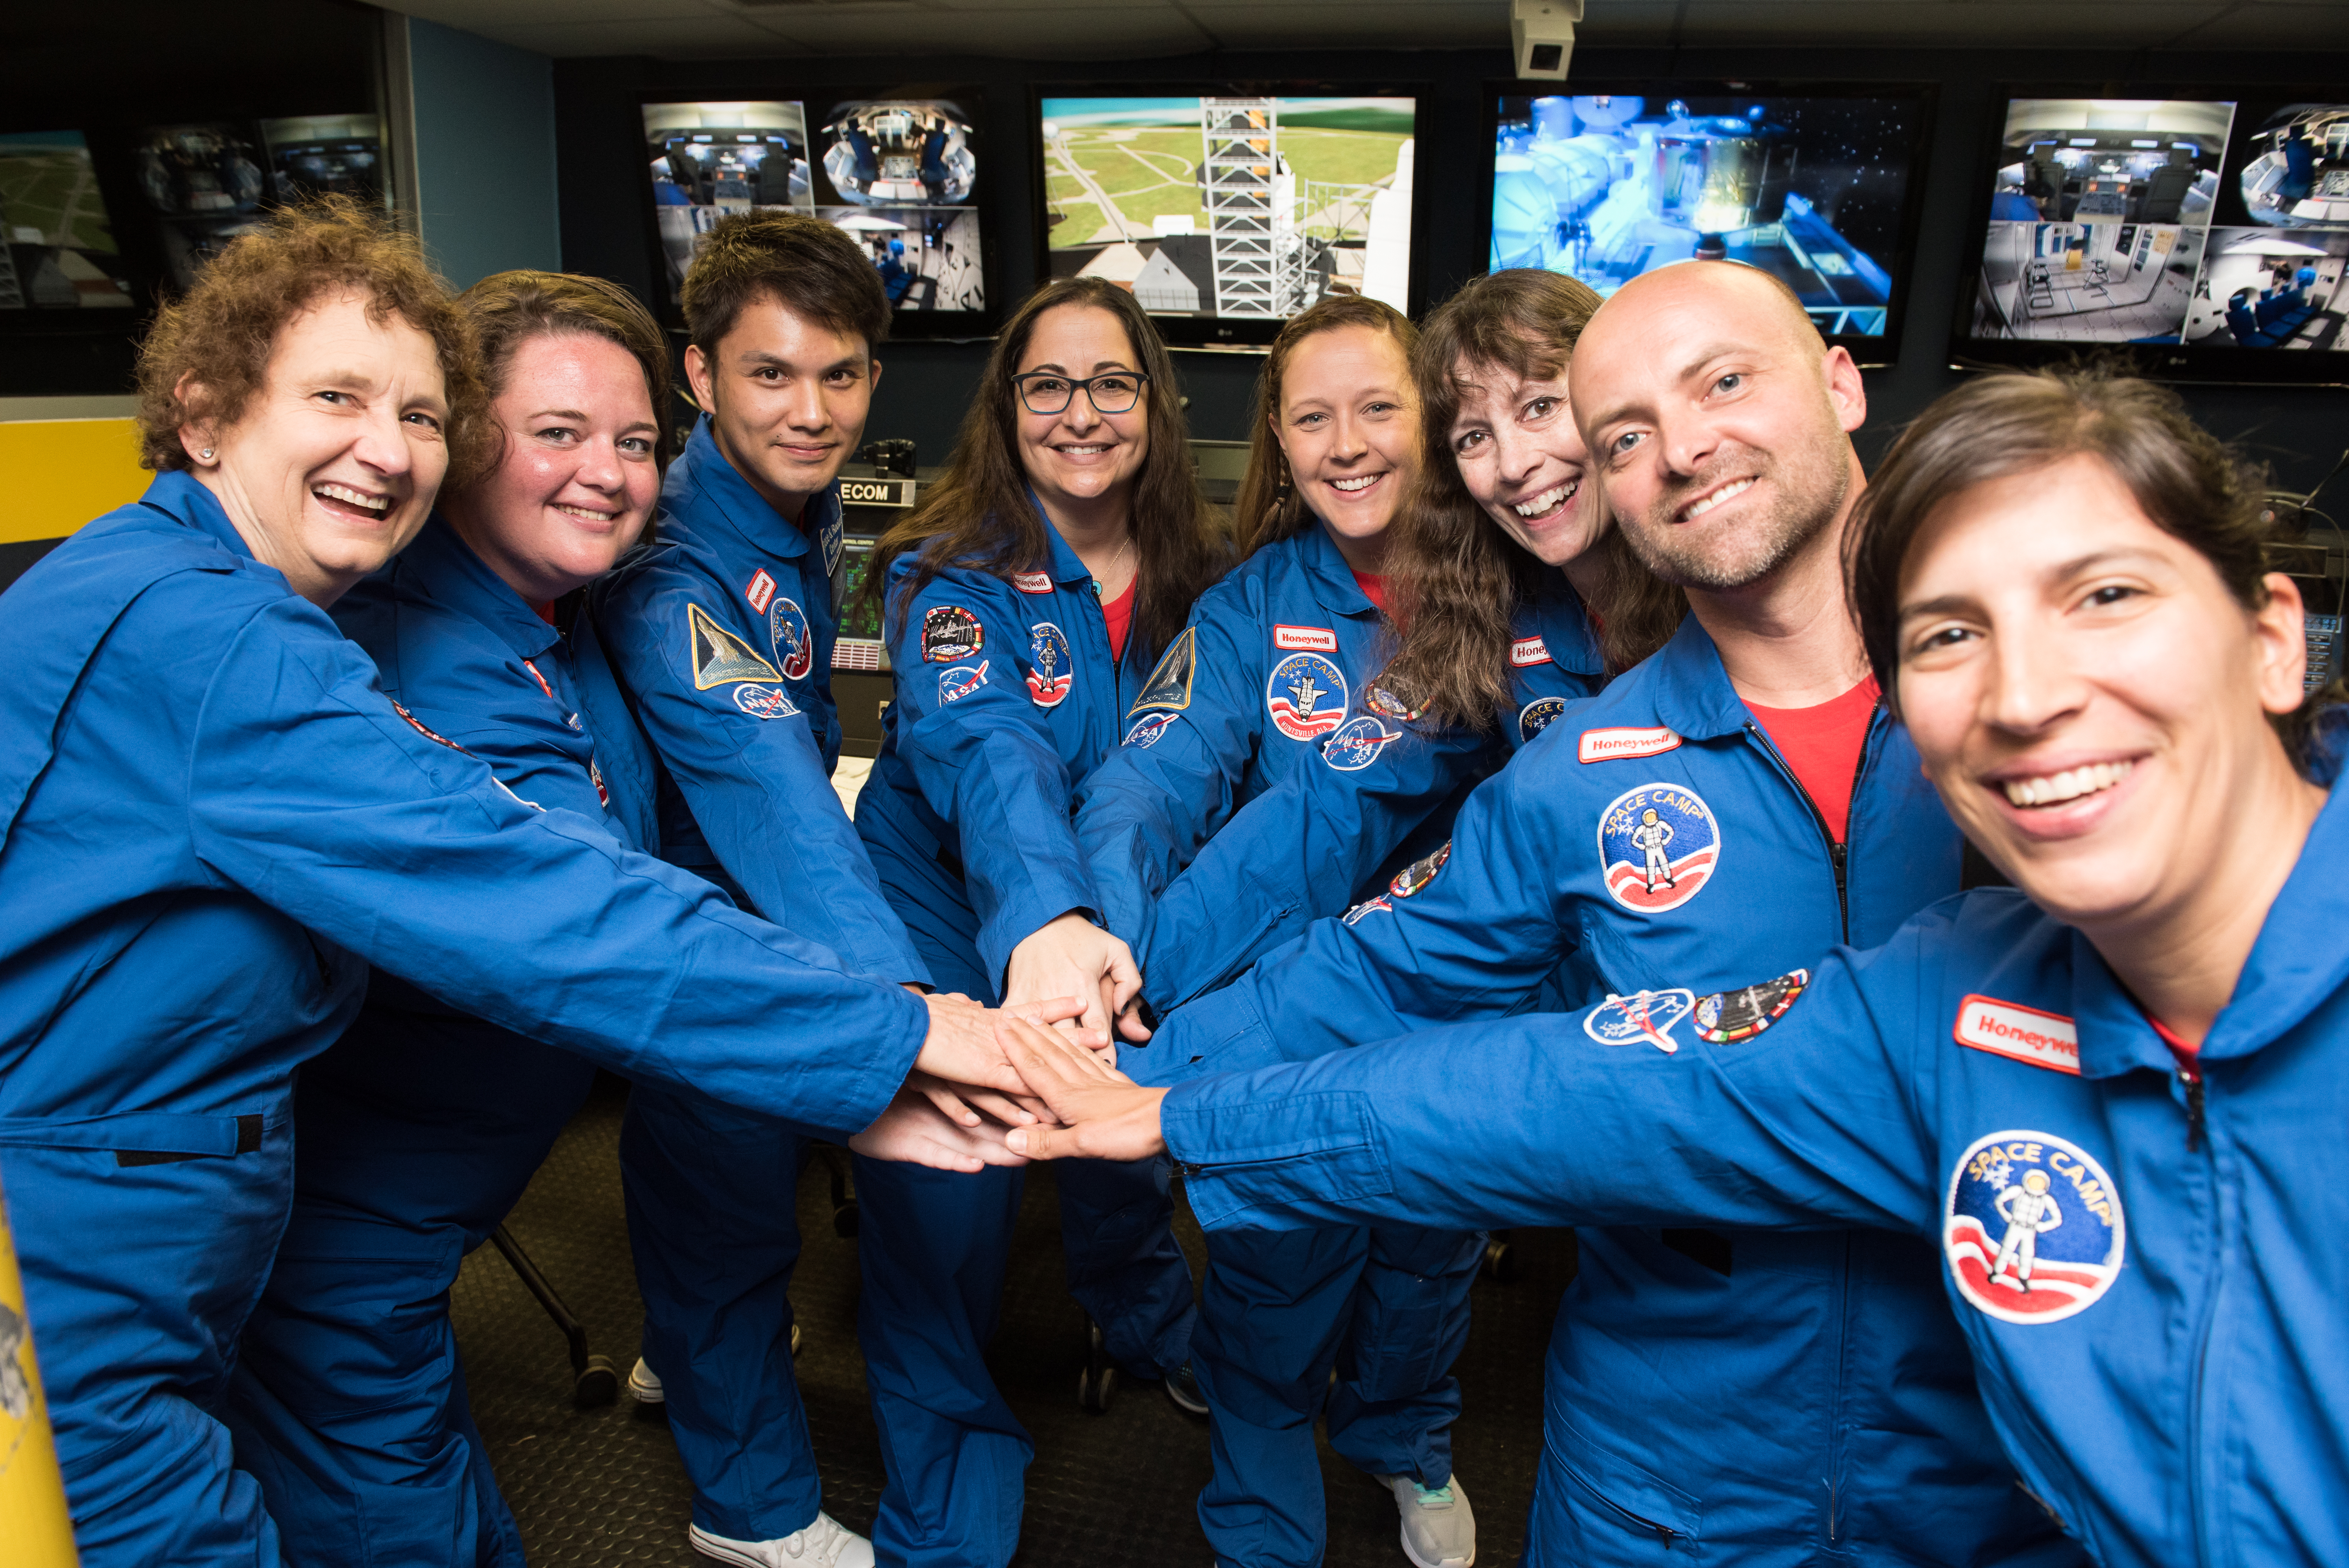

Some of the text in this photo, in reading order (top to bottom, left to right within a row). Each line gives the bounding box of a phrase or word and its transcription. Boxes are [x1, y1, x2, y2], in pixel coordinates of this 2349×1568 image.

[752, 578, 769, 606] Honeywell
[1014, 578, 1047, 588] neywell
[1033, 628, 1050, 642] ACE
[1282, 633, 1329, 645] Honeywell
[1279, 658, 1340, 686] SPACE CAMP
[744, 698, 790, 712] NASA
[1525, 703, 1553, 728] SPACE
[1334, 734, 1373, 757] NASA
[1593, 733, 1669, 751] Honeywell
[1605, 791, 1700, 837] SPACE CAMP
[1968, 1143, 2111, 1220] SPACE CAMP
